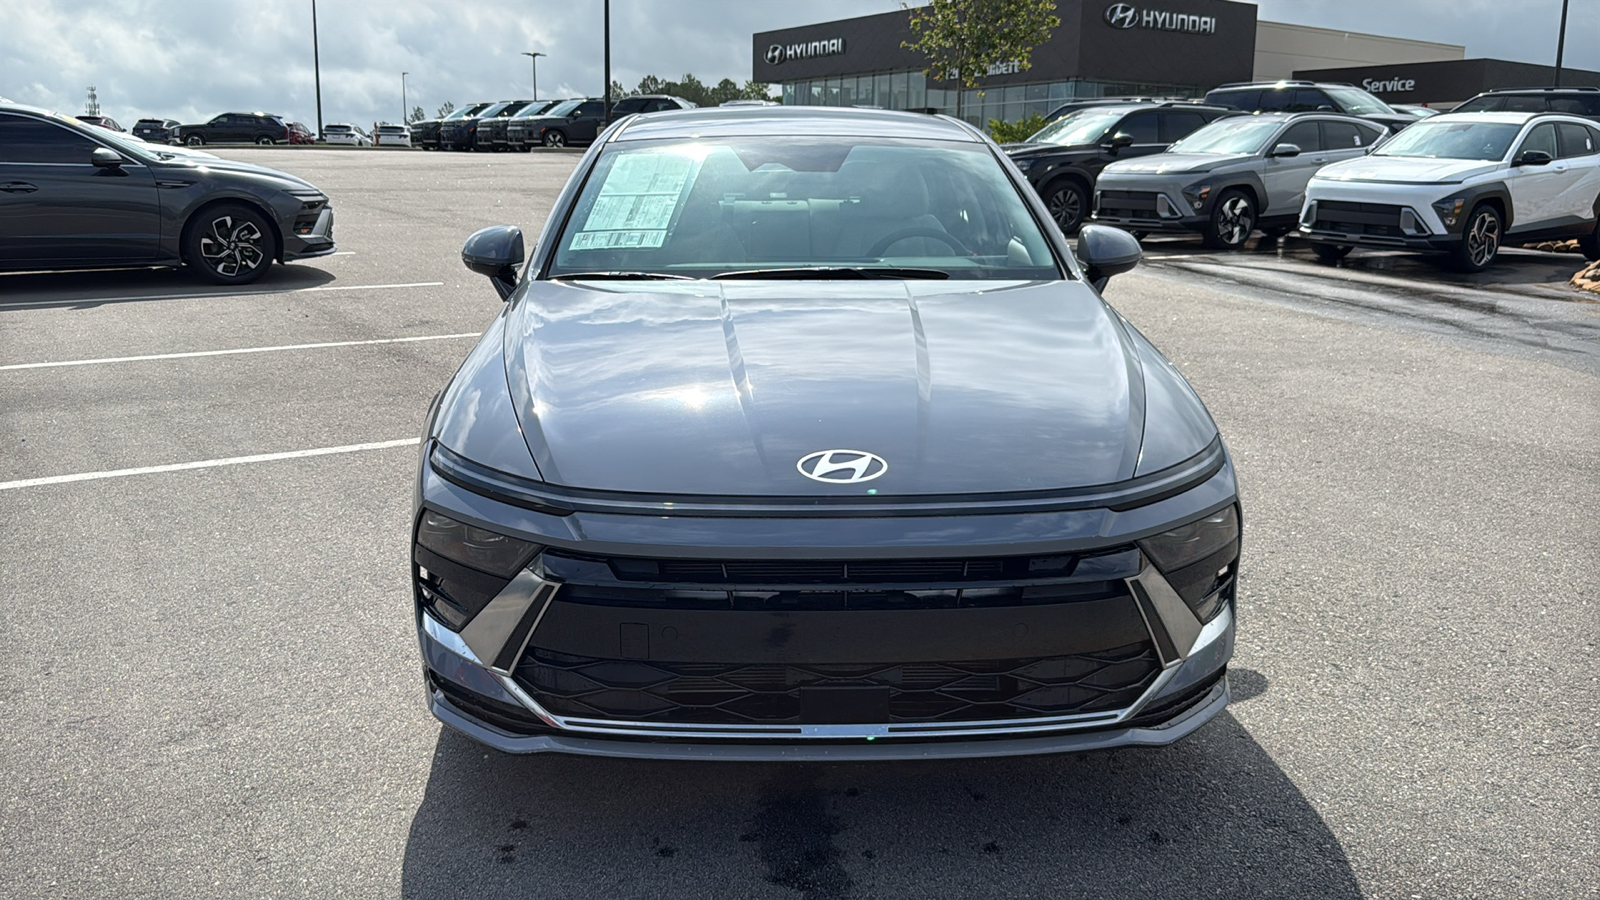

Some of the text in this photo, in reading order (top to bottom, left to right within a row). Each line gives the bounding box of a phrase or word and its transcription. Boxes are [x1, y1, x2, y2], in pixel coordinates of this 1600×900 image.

[1142, 9, 1216, 33] HYUNDAI
[786, 37, 843, 59] HYUNDAI
[1362, 76, 1415, 93] Service
